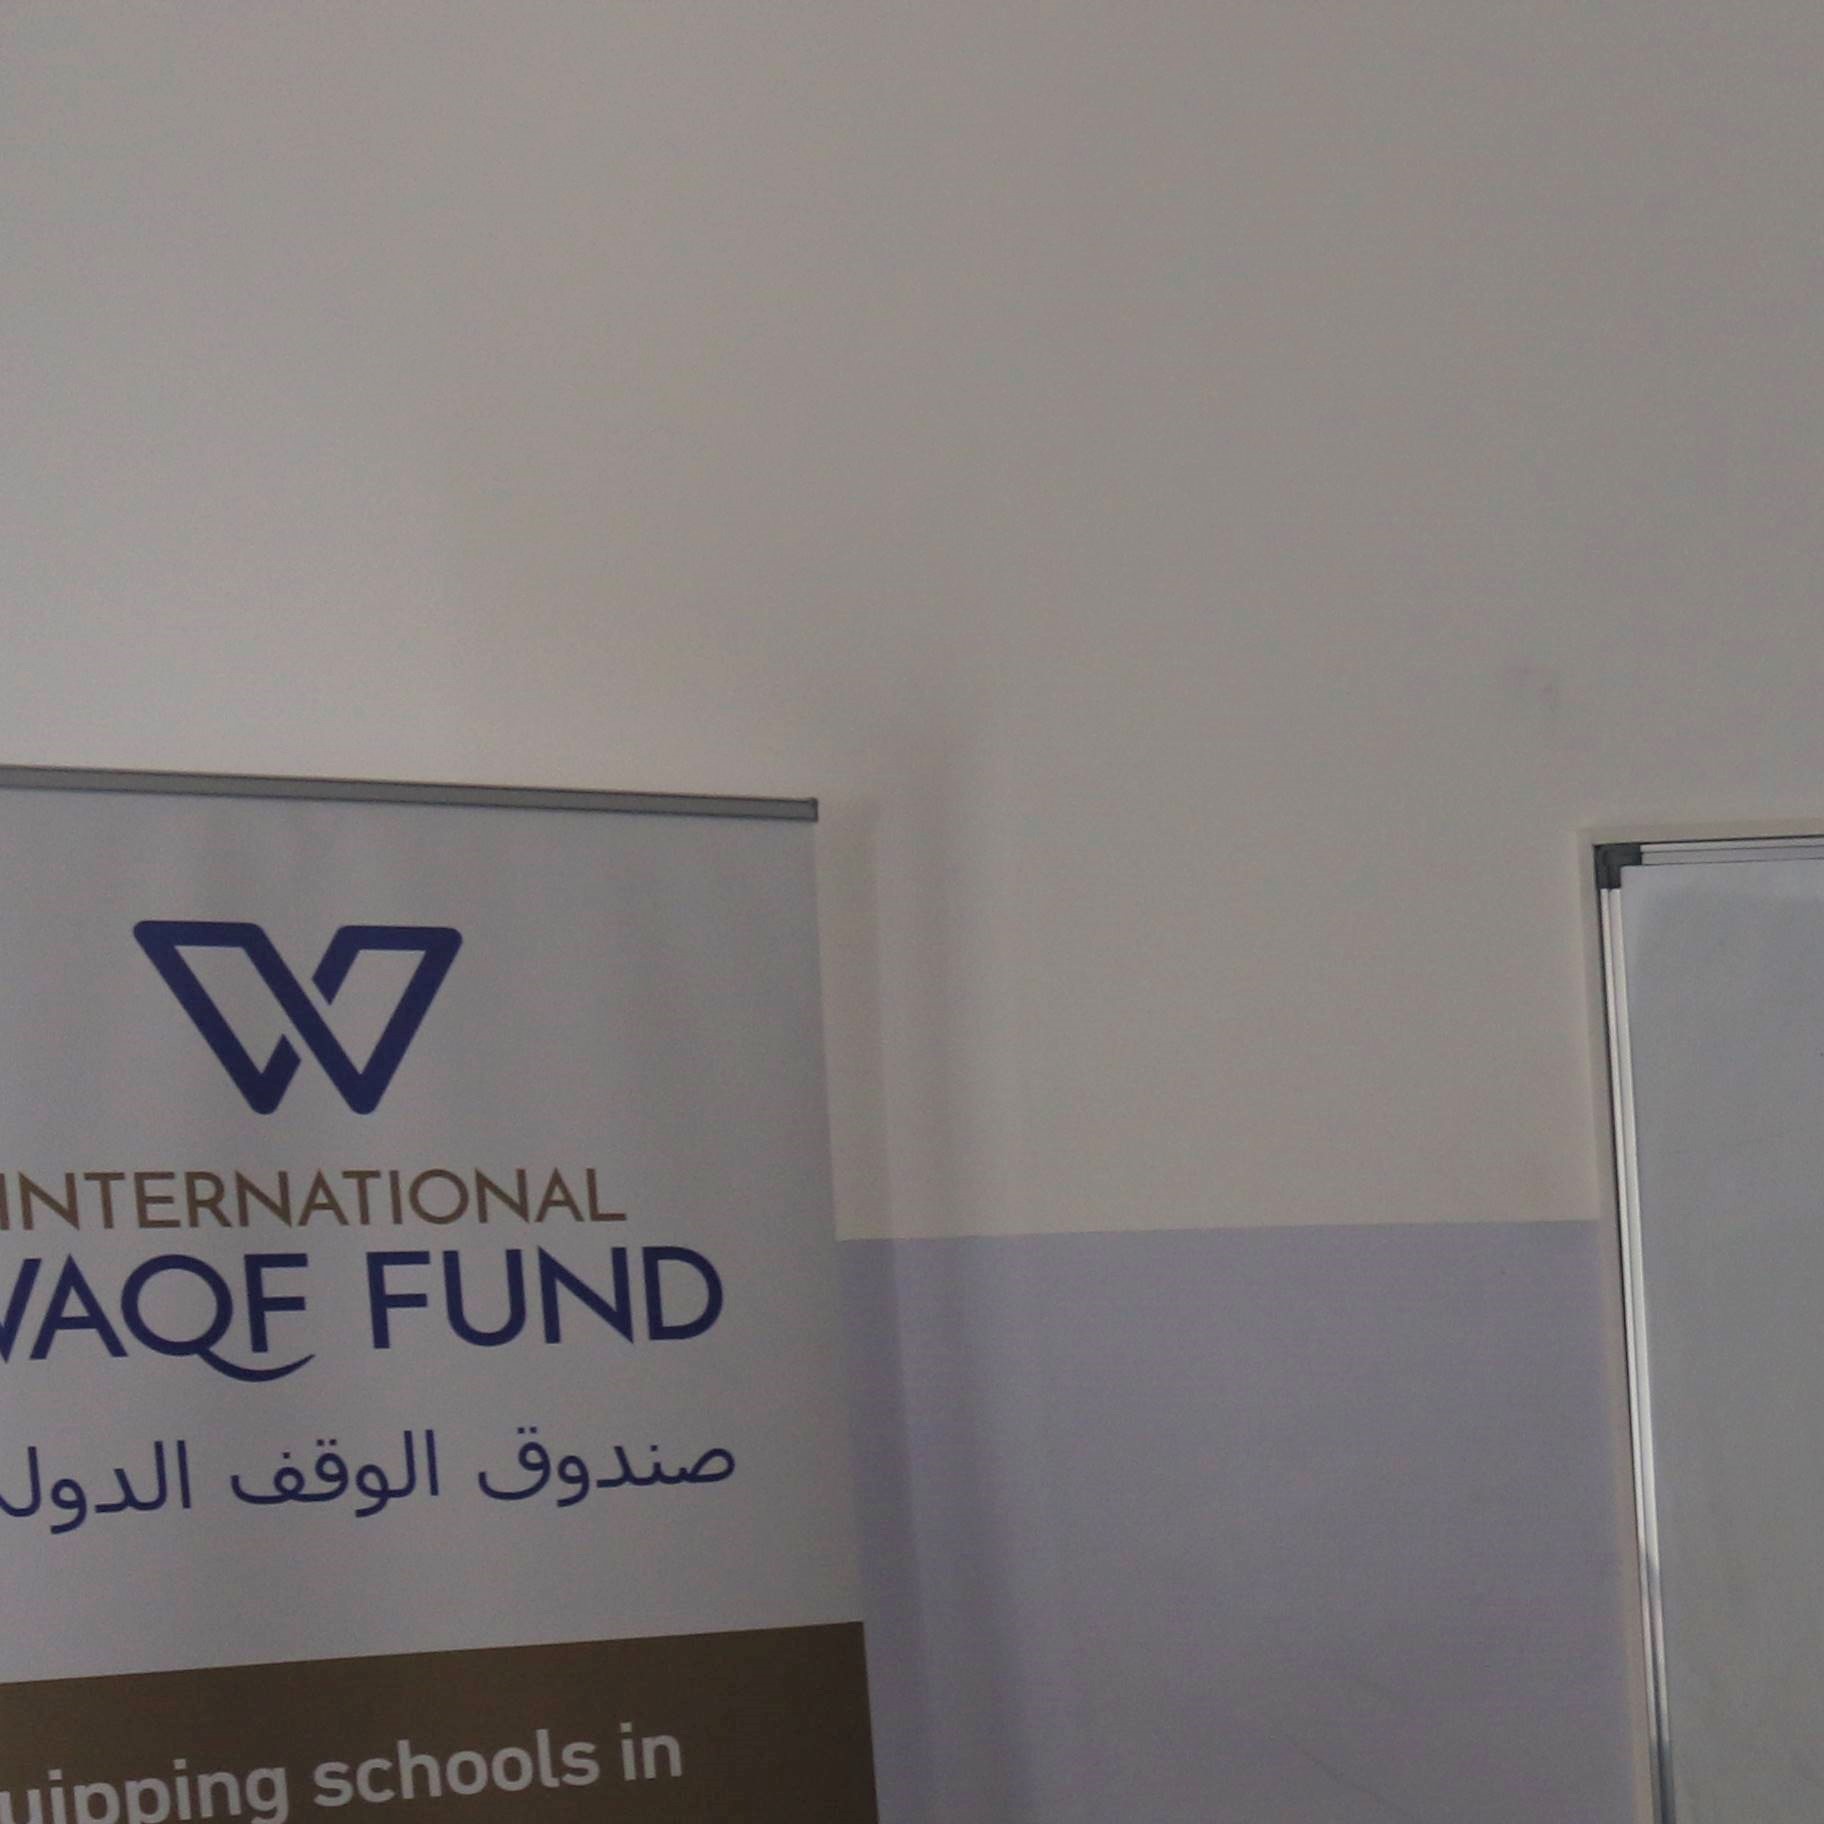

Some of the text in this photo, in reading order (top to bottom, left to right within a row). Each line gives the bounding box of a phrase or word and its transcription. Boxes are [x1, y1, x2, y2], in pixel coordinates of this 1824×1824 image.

[0, 1168, 628, 1231] INTERNATIONAL
[367, 1246, 724, 1350] FUND
[230, 1430, 440, 1519] الوقف
[478, 1428, 737, 1508] صندوق
[313, 1728, 600, 1807] schools
[620, 1722, 682, 1781] in
